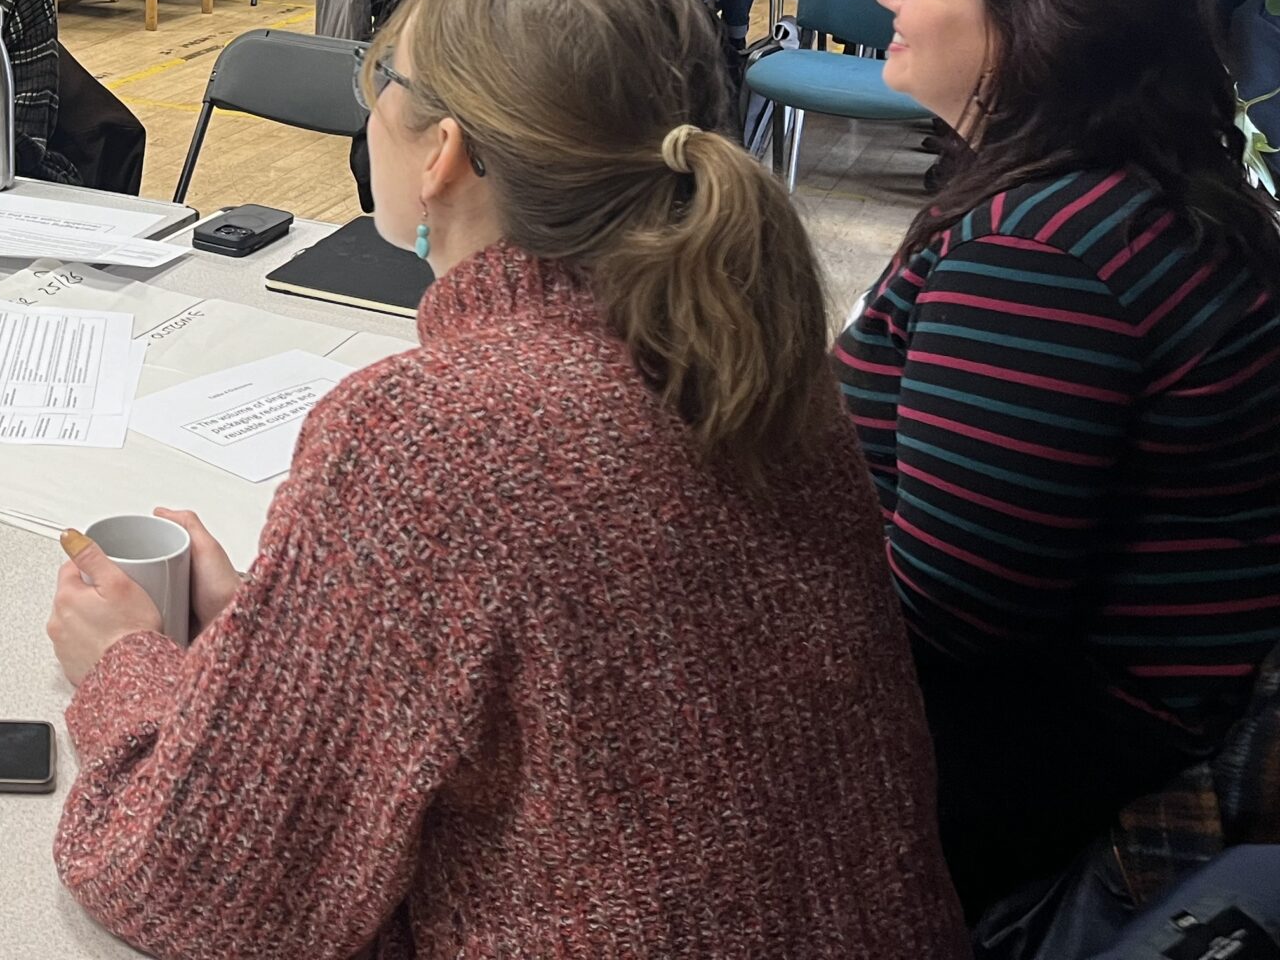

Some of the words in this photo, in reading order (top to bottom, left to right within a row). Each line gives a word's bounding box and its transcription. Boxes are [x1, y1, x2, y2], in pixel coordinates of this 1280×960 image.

[38, 271, 84, 296] 25/26
[151, 310, 206, 340] OUTCOME
[198, 418, 218, 429] The
[220, 406, 254, 422] volume
[253, 400, 265, 410] of
[265, 385, 312, 404] single-use
[211, 414, 262, 435] packaging
[260, 398, 298, 416] reduces
[298, 392, 317, 403] and
[224, 420, 266, 440] reusable
[266, 411, 291, 425] cups
[290, 404, 307, 415] are
